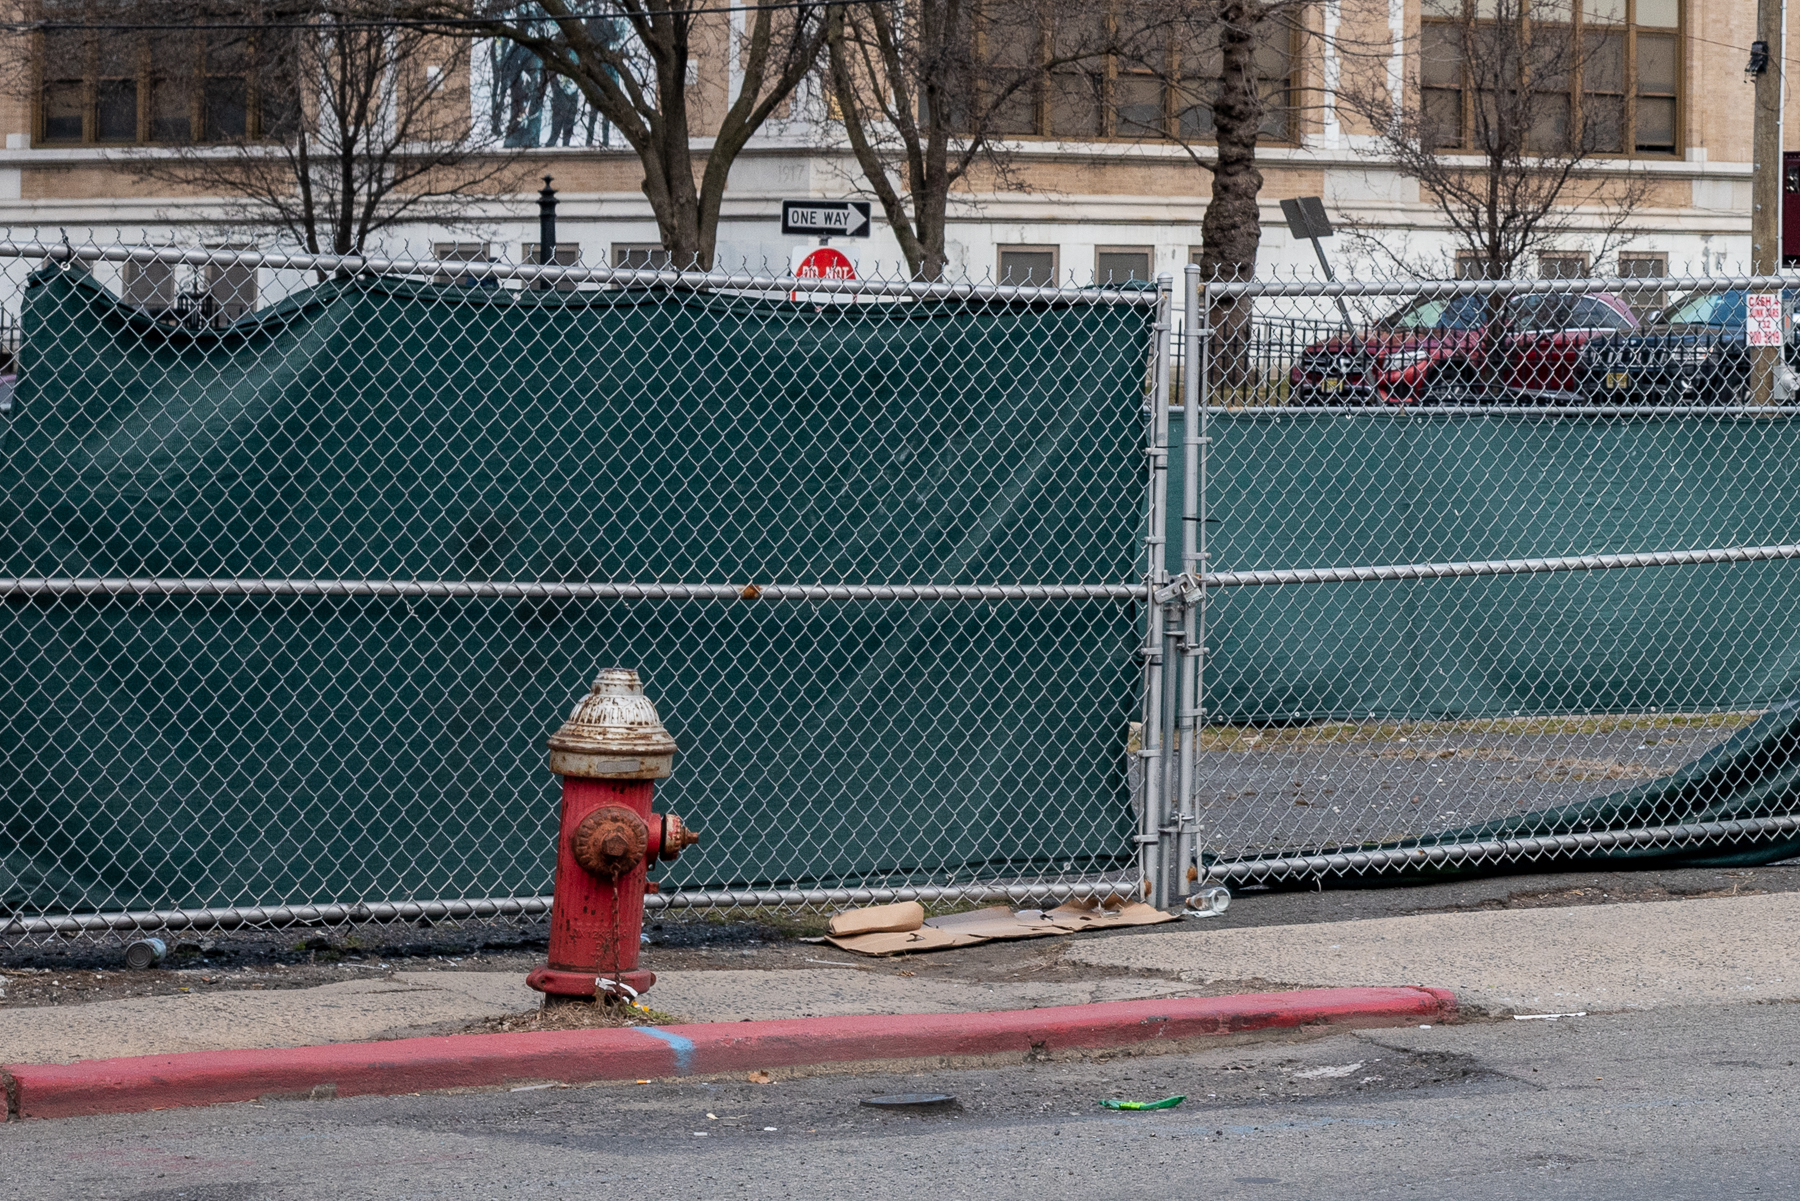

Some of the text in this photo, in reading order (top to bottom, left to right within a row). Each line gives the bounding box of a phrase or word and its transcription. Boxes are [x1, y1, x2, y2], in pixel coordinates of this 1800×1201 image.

[791, 209, 850, 226] ONE WAY
[802, 265, 849, 279] DO NOT
[1749, 297, 1771, 307] CASH
